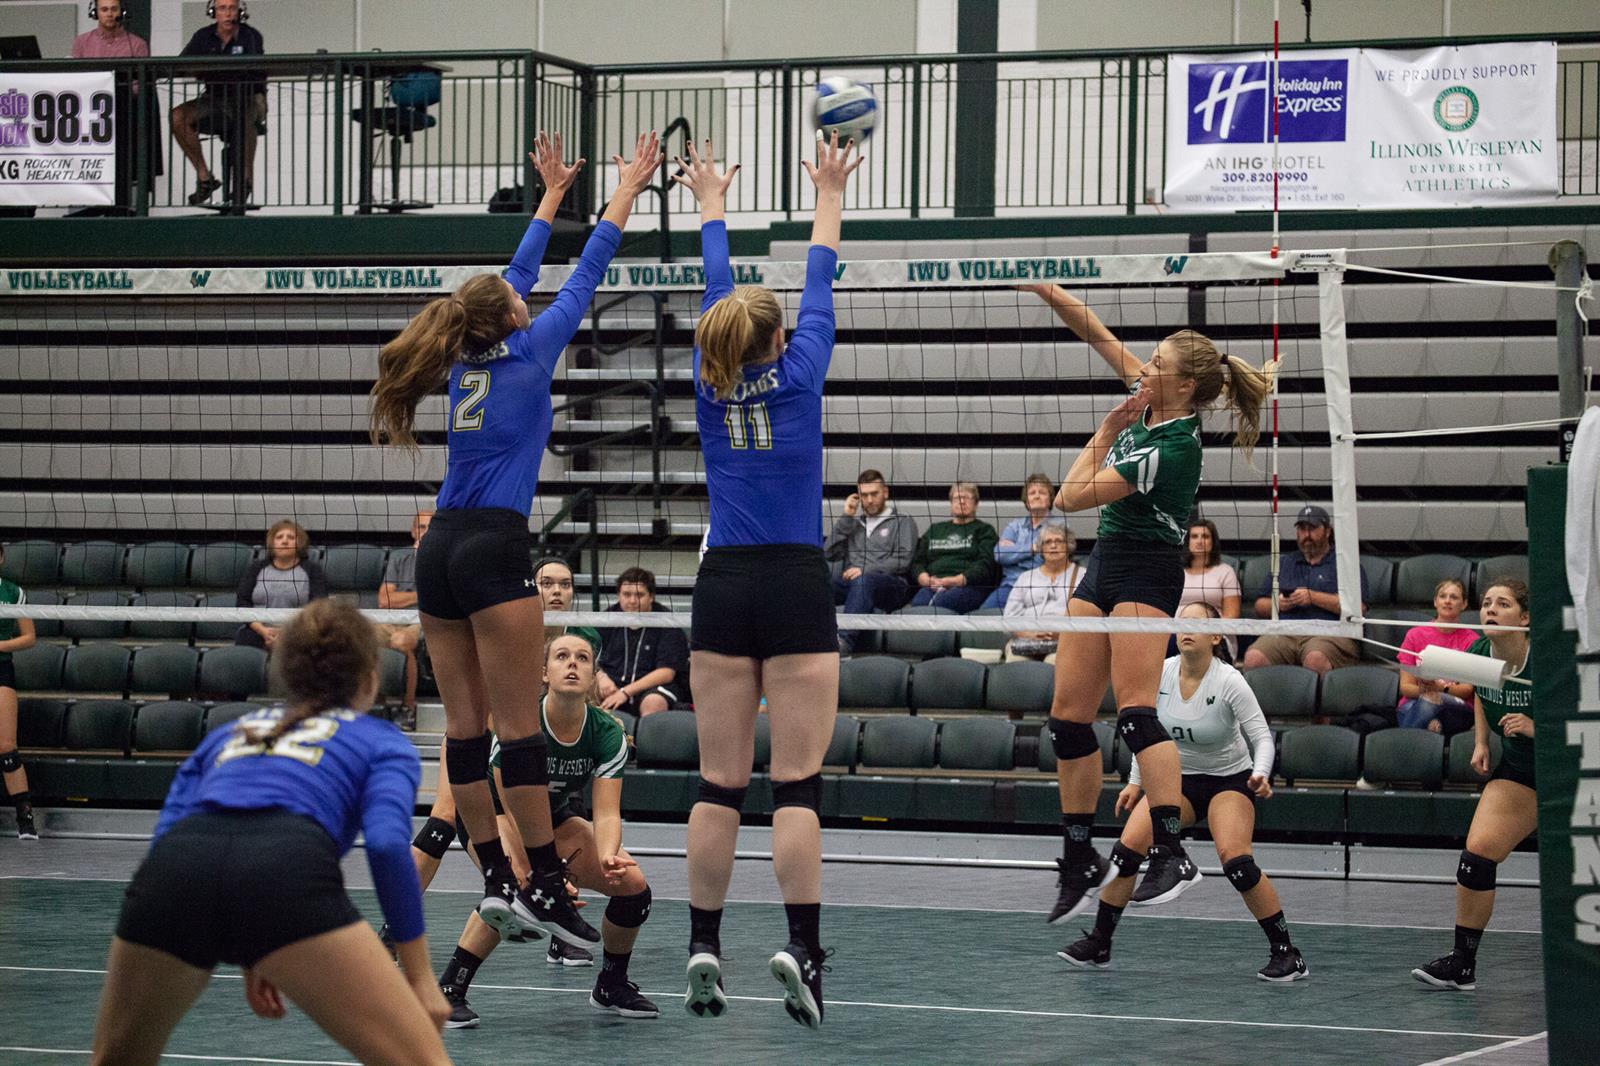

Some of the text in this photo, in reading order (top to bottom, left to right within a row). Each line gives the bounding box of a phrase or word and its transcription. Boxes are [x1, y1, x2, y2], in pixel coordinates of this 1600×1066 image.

[1375, 63, 1537, 82] WE PROUDLY SUPPORT
[1322, 76, 1342, 91] Inn
[1274, 95, 1343, 117] Express
[33, 92, 113, 144] 98.3
[80, 158, 106, 169] THE
[1203, 157, 1227, 170] AN
[1271, 155, 1325, 170] HOTEL
[1409, 162, 1503, 175] UNIVERSITY
[26, 170, 103, 181] HEARTLAND
[1222, 172, 1308, 183] 309.8209990
[1402, 176, 1512, 193] ATHLETICS
[265, 268, 442, 289] IWU VOLLEYBALL
[628, 263, 763, 287] VOLLEYALL
[907, 257, 1102, 282] IWU VOLLEYBALL
[7, 270, 133, 290] VOLLEYBALL
[452, 369, 491, 432] 2
[724, 401, 772, 449] 11
[1205, 695, 1216, 706] W
